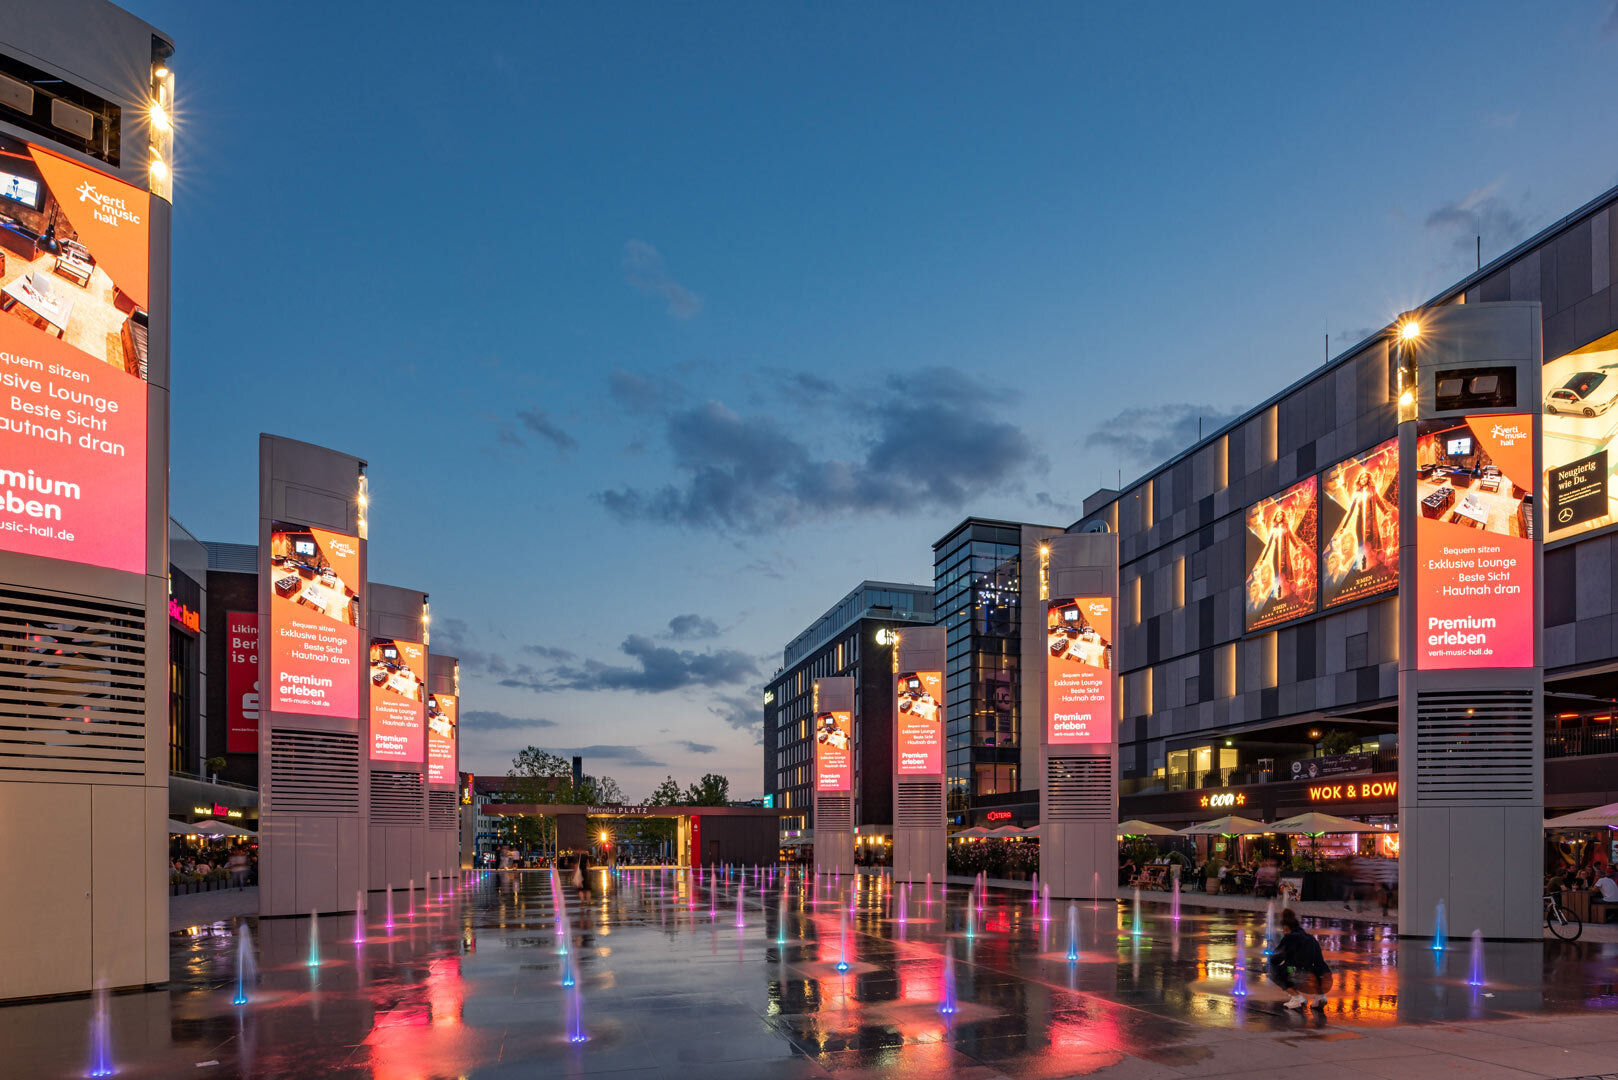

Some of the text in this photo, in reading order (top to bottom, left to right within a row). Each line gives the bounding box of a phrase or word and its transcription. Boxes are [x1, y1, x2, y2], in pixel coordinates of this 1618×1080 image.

[95, 192, 126, 210] verti
[94, 209, 118, 227] hall
[102, 204, 140, 224] music
[48, 364, 90, 383] sitzen
[0, 372, 119, 413] sive Lounge
[11, 396, 107, 431] Beste Sicht
[1504, 431, 1527, 439] music
[79, 433, 125, 456] dran
[1558, 461, 1596, 481] Neugierig
[1558, 480, 1572, 490] wie
[1443, 547, 1476, 555] Bequem
[1428, 558, 1517, 570] Exklusive Lounge
[1458, 571, 1510, 582] Beste Sicht
[1443, 583, 1521, 596] Hautnah dran
[232, 624, 258, 634] Likin
[292, 620, 317, 630] Bequem
[1428, 615, 1496, 630] Premium
[280, 628, 348, 646] Exklusive Lounge
[1428, 631, 1486, 646] erleben
[304, 642, 343, 654] Beste Sicht
[1428, 648, 1493, 656] verti-music-hall.de
[232, 650, 245, 663] is
[291, 650, 350, 665] Hautnah dran
[280, 672, 333, 687] Premium
[280, 684, 325, 697] erleben
[1053, 712, 1091, 720] Premium
[1053, 721, 1086, 730] erleben
[375, 733, 408, 743] Premium
[375, 741, 403, 750] erleben
[1310, 786, 1341, 800] WOK
[1347, 785, 1356, 797] &
[587, 806, 616, 814] Mercedes
